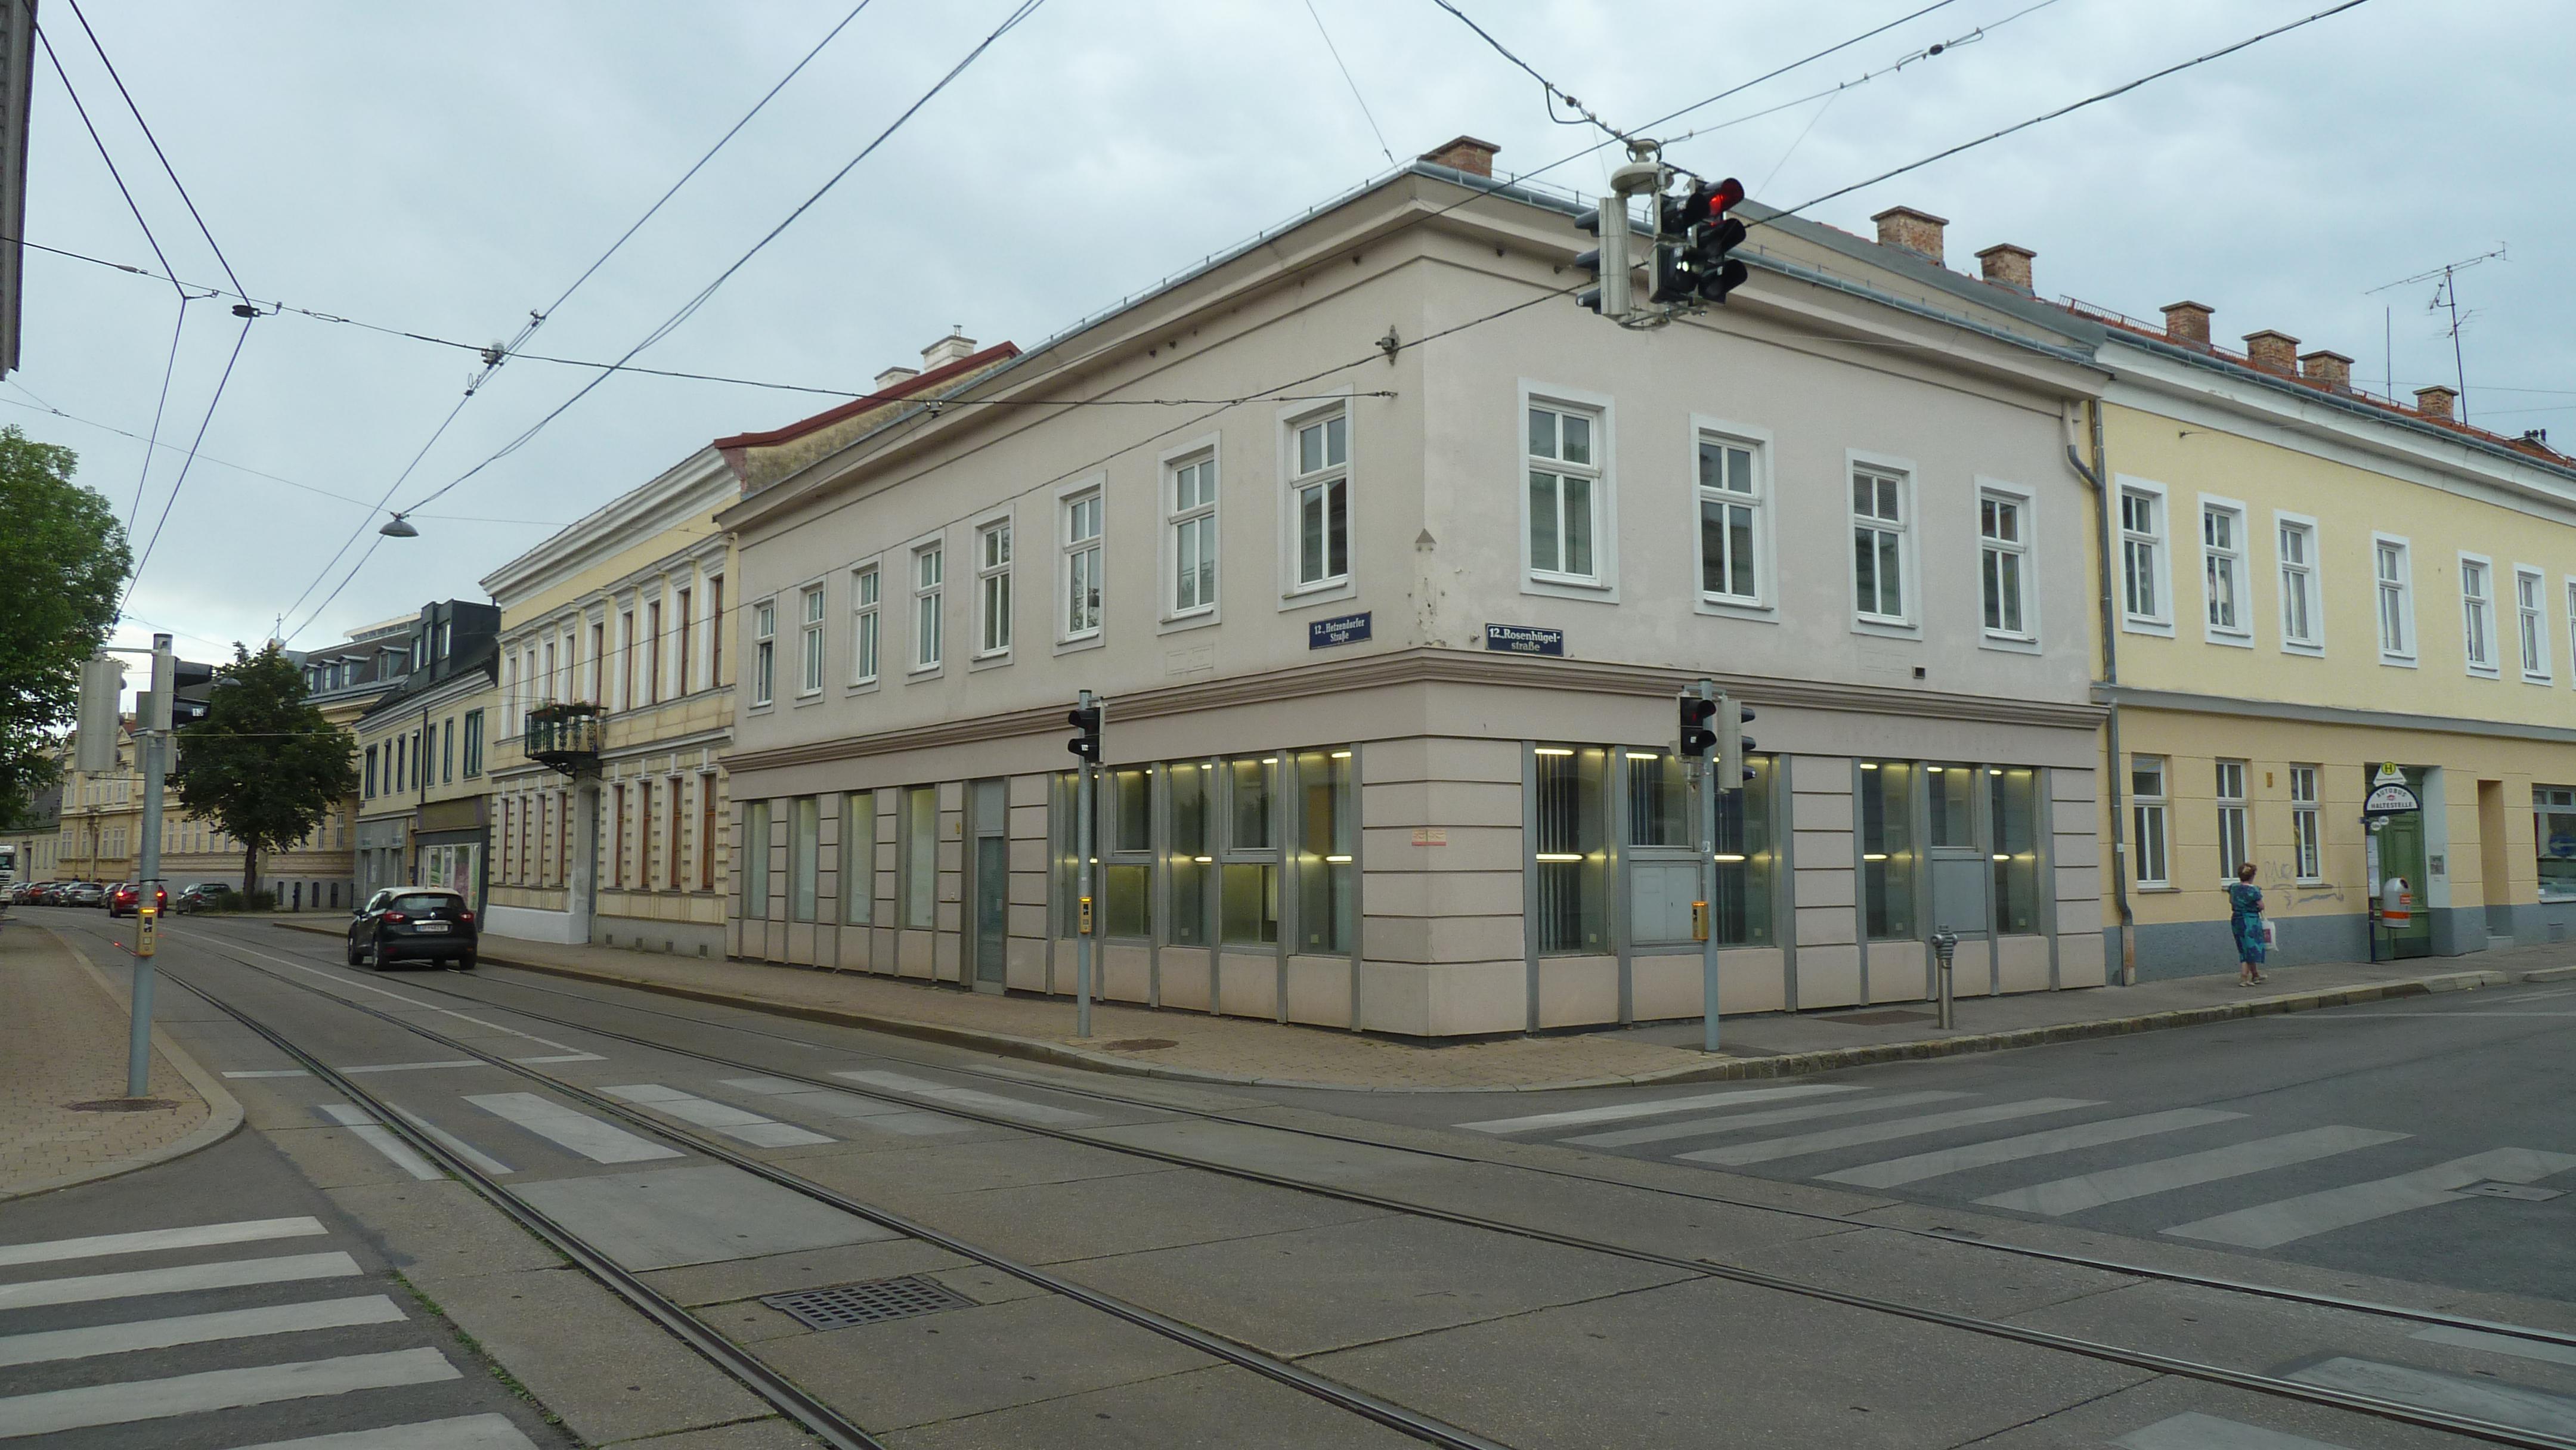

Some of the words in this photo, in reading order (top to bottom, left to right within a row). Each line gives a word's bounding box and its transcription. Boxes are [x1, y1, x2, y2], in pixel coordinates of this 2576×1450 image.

[1326, 618, 1365, 633] Hetzendorfer
[1330, 630, 1349, 642] Straße
[1503, 628, 1561, 644] Rosenhügel-
[1511, 641, 1540, 651] straße
[2385, 764, 2392, 773] H
[2376, 788, 2407, 798] AUTOBUS
